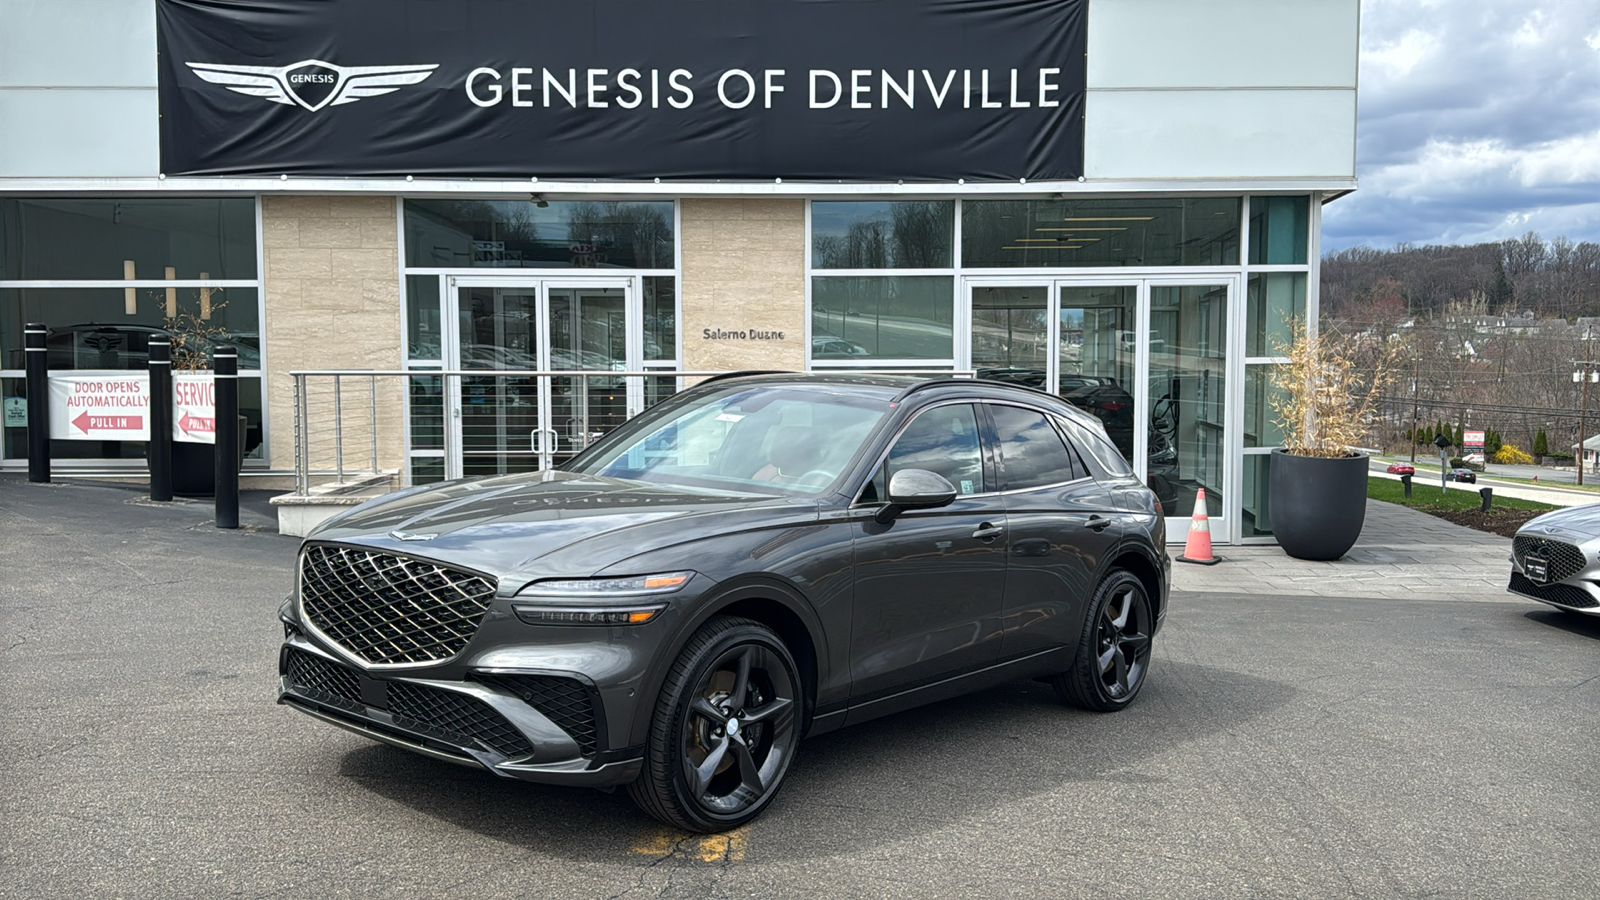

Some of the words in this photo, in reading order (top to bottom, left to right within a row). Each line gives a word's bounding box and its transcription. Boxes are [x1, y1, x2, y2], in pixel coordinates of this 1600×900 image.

[290, 74, 335, 84] GENESIS
[465, 66, 694, 109] GENESIS
[717, 68, 786, 109] OF
[809, 67, 1060, 109] DENVILLE
[703, 328, 747, 340] Salerno
[749, 328, 785, 340] Duane
[75, 382, 103, 393] DOOR
[106, 381, 140, 393] OPENS
[176, 382, 215, 407] SERVIC
[67, 395, 149, 407] AUTOMATICALLY
[90, 417, 113, 428] PULL
[117, 417, 127, 428] IN
